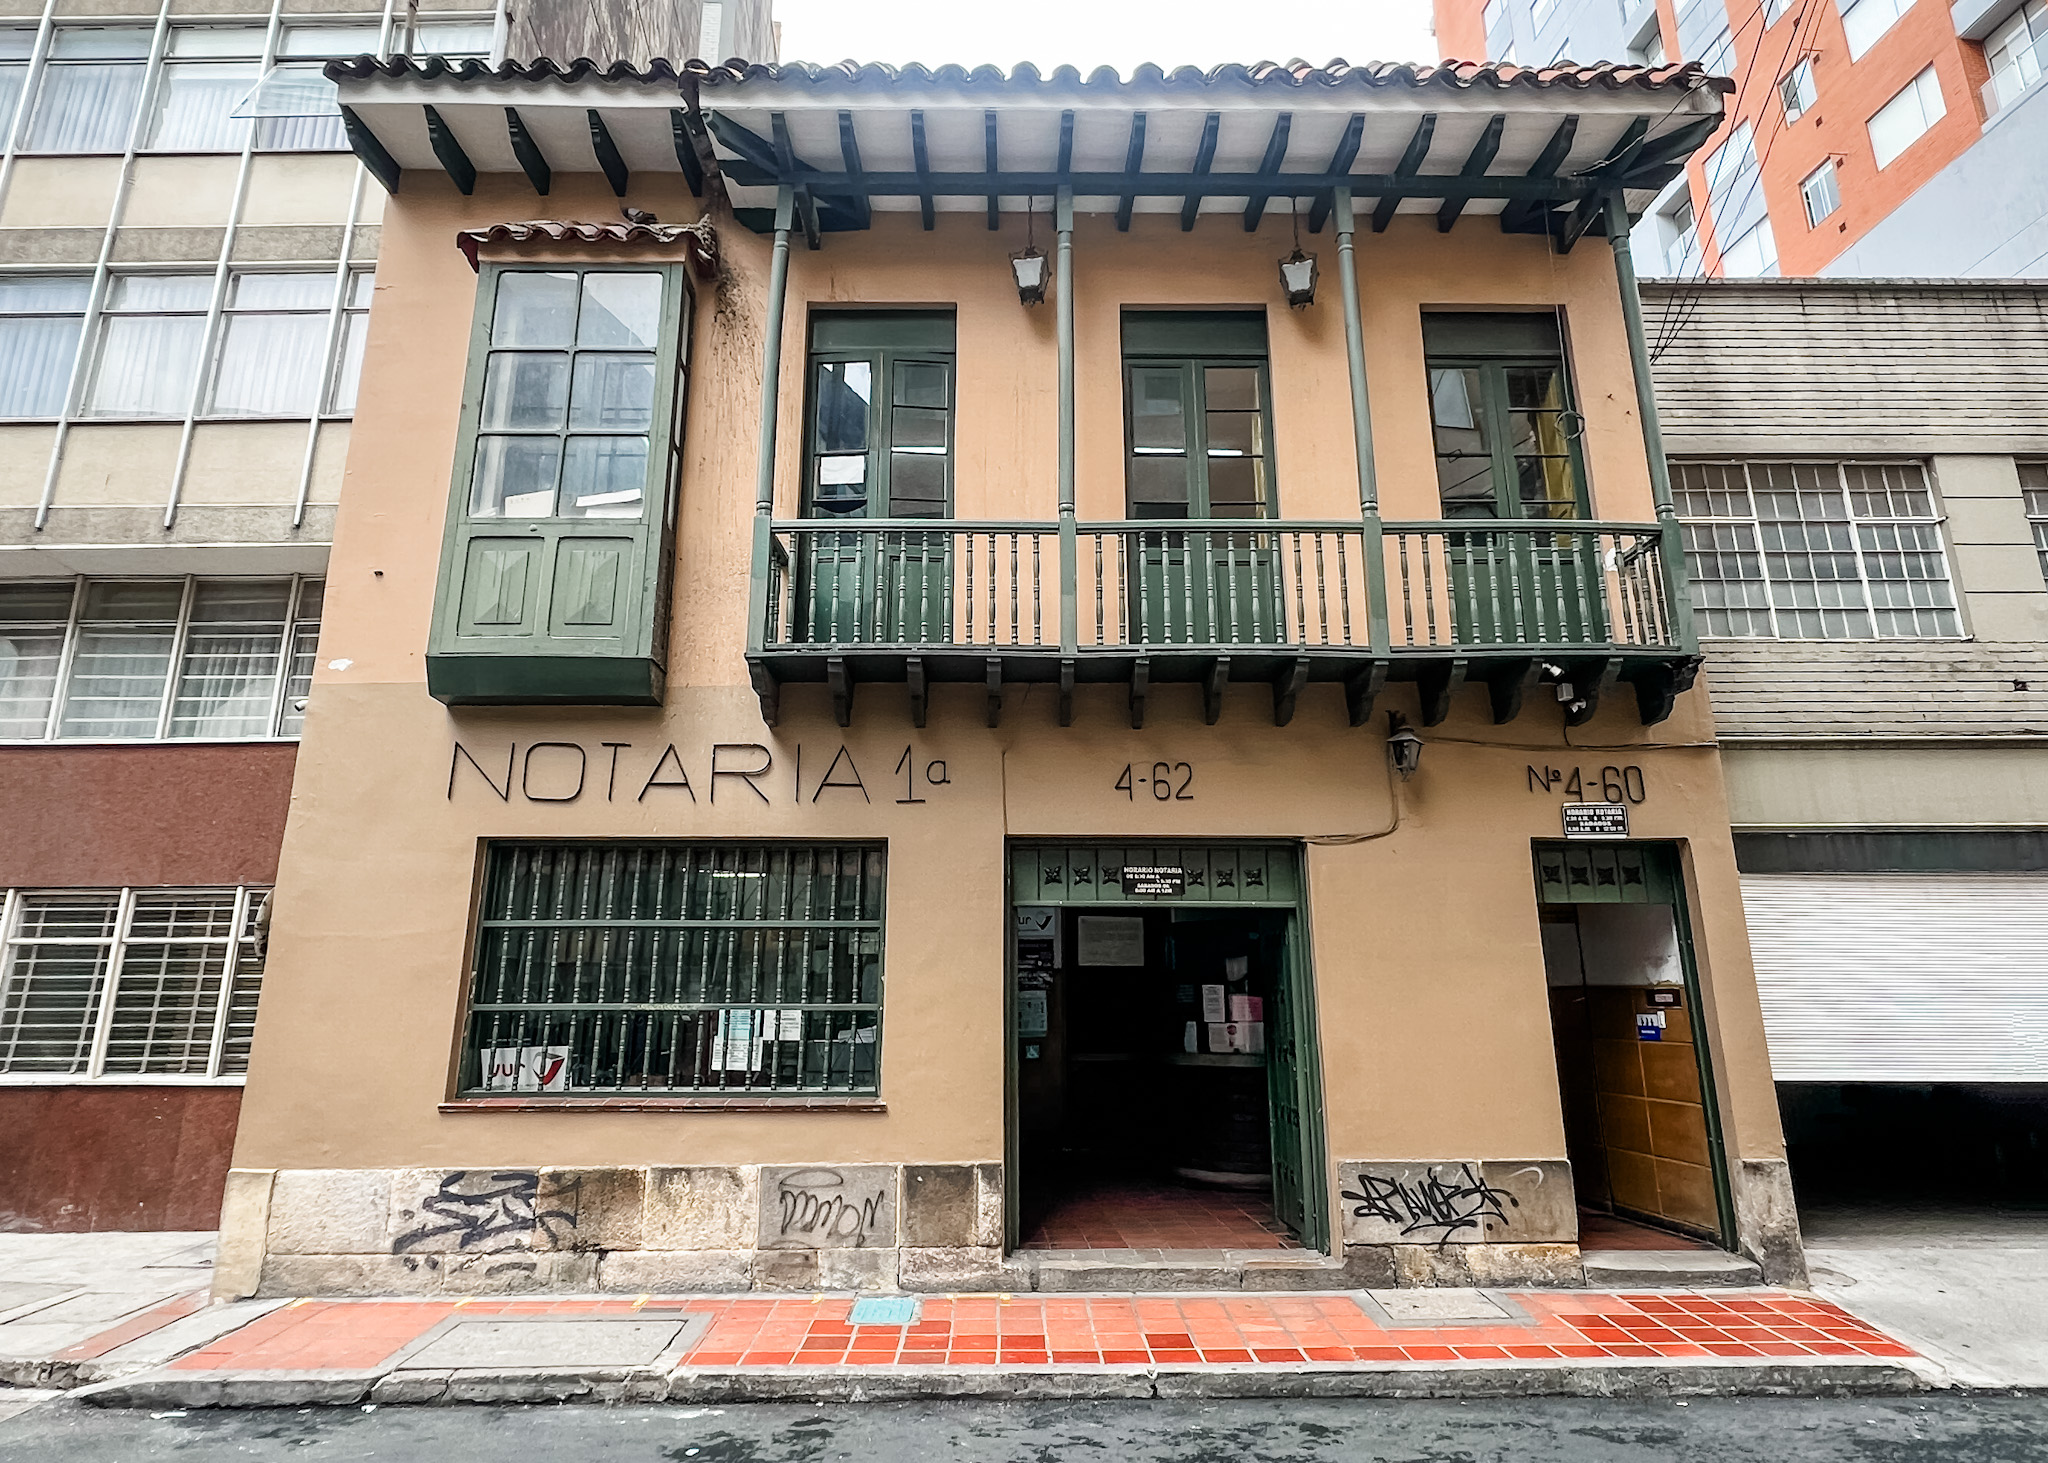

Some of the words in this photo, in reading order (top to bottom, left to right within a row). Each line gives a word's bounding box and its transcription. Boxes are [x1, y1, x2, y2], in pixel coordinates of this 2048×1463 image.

[448, 741, 871, 805] NOTARIA
[1114, 762, 1194, 802] 4-62
[1564, 765, 1646, 804] 4-60
